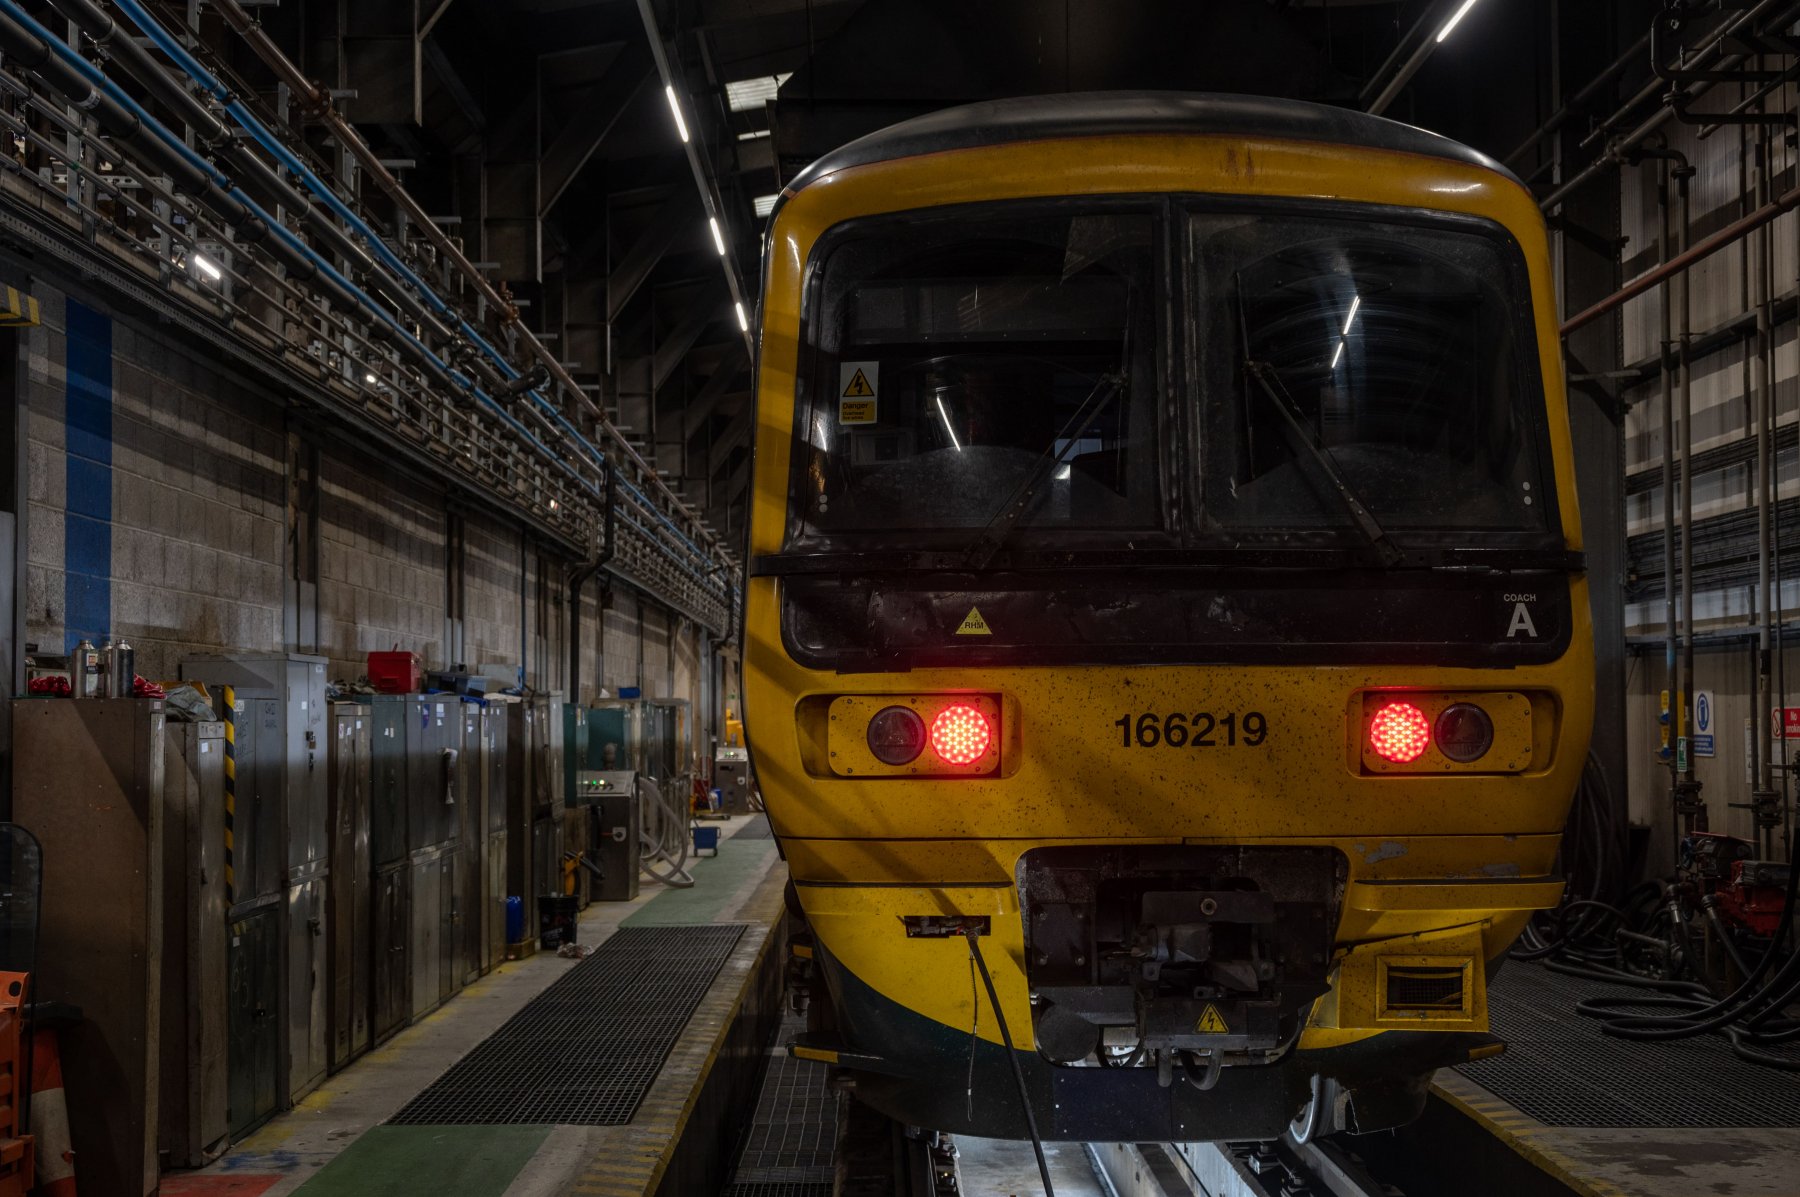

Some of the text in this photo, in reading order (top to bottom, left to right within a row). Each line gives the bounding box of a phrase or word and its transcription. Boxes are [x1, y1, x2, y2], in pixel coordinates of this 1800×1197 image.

[843, 402, 868, 410] Danger
[1503, 593, 1537, 602] COACH
[1506, 602, 1538, 637] A
[964, 621, 984, 629] RHM
[1115, 711, 1267, 748] 166219
